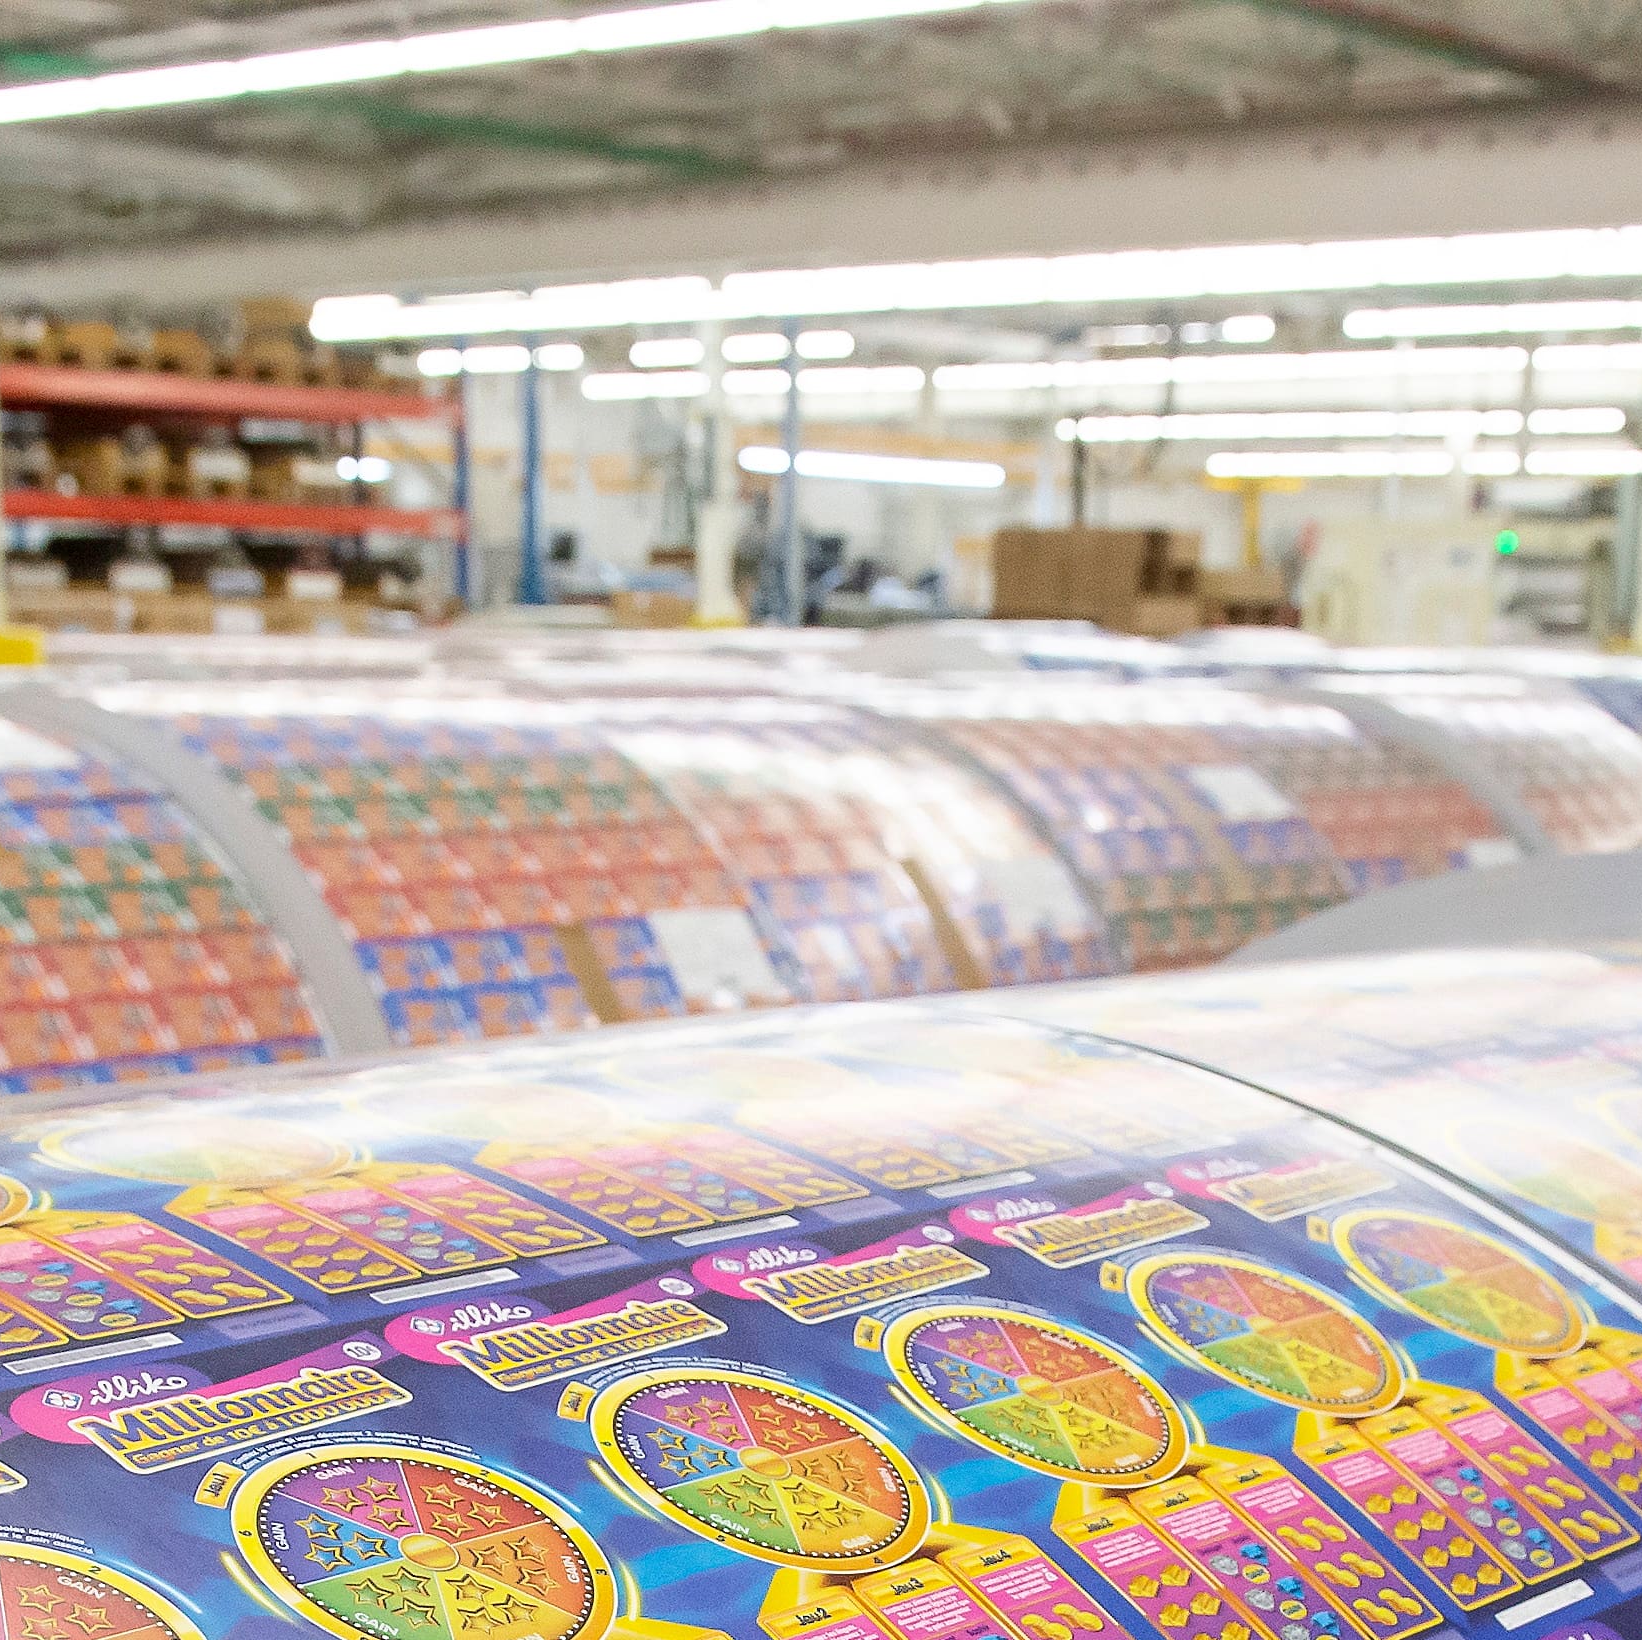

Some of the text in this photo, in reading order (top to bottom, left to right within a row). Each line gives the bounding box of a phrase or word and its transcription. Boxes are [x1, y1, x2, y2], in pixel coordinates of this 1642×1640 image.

[448, 1299, 698, 1370] Millionnaire
[450, 1303, 532, 1333] illiko
[91, 1373, 187, 1405] illiko
[81, 1369, 380, 1451] Millionnaire
[132, 1440, 198, 1464] Gagner
[202, 1432, 224, 1448] de
[228, 1424, 265, 1440] 10€
[57, 1575, 108, 1599] GAIN
